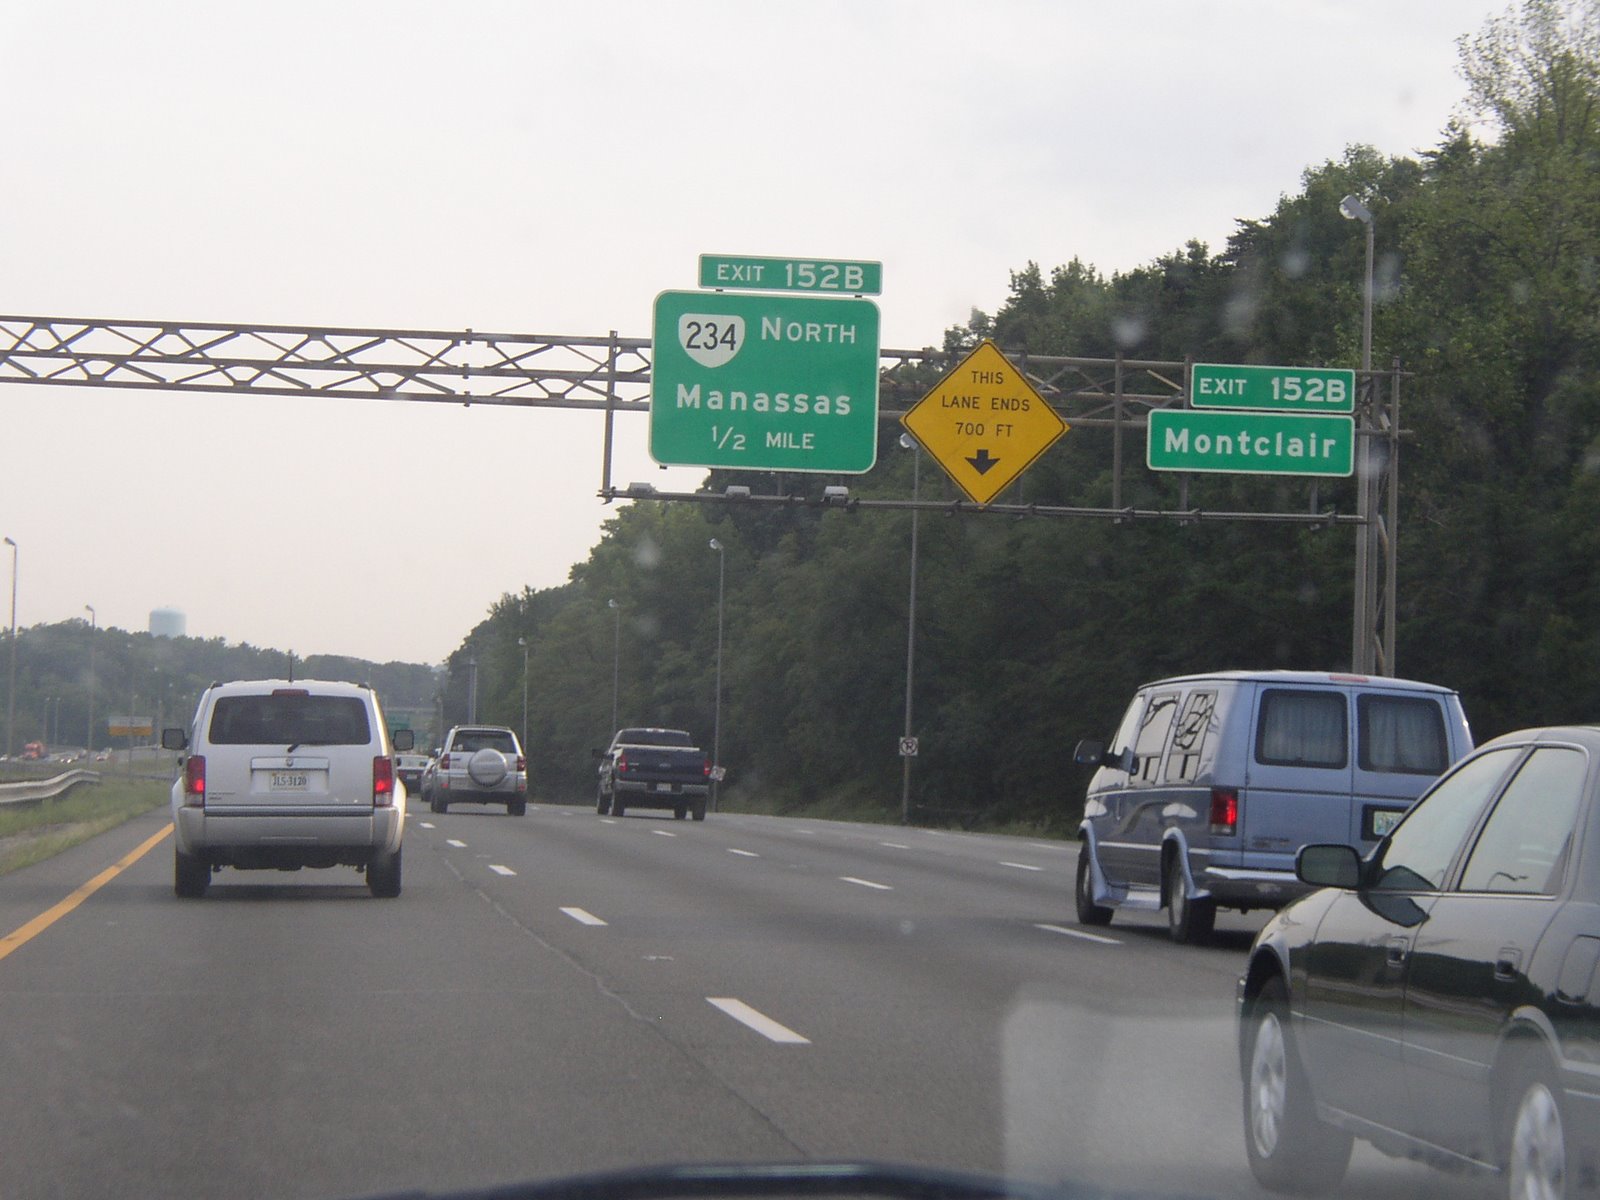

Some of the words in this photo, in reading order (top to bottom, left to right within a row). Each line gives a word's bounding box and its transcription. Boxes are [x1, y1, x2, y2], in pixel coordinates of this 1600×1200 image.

[717, 263, 765, 282] EXIT
[785, 263, 864, 290] 152B
[686, 321, 736, 351] 234
[761, 316, 856, 344] NORTH
[971, 371, 1004, 385] THIS
[1200, 378, 1247, 395] EXIT
[1270, 376, 1346, 403] 152B
[676, 383, 851, 416] Manassas
[942, 395, 980, 409] LANE
[991, 398, 1030, 412] ENDS
[711, 425, 746, 450] 1/2
[766, 431, 815, 450] MILE
[955, 422, 985, 436] 700
[996, 424, 1014, 437] FT
[1164, 427, 1336, 458] Montclair
